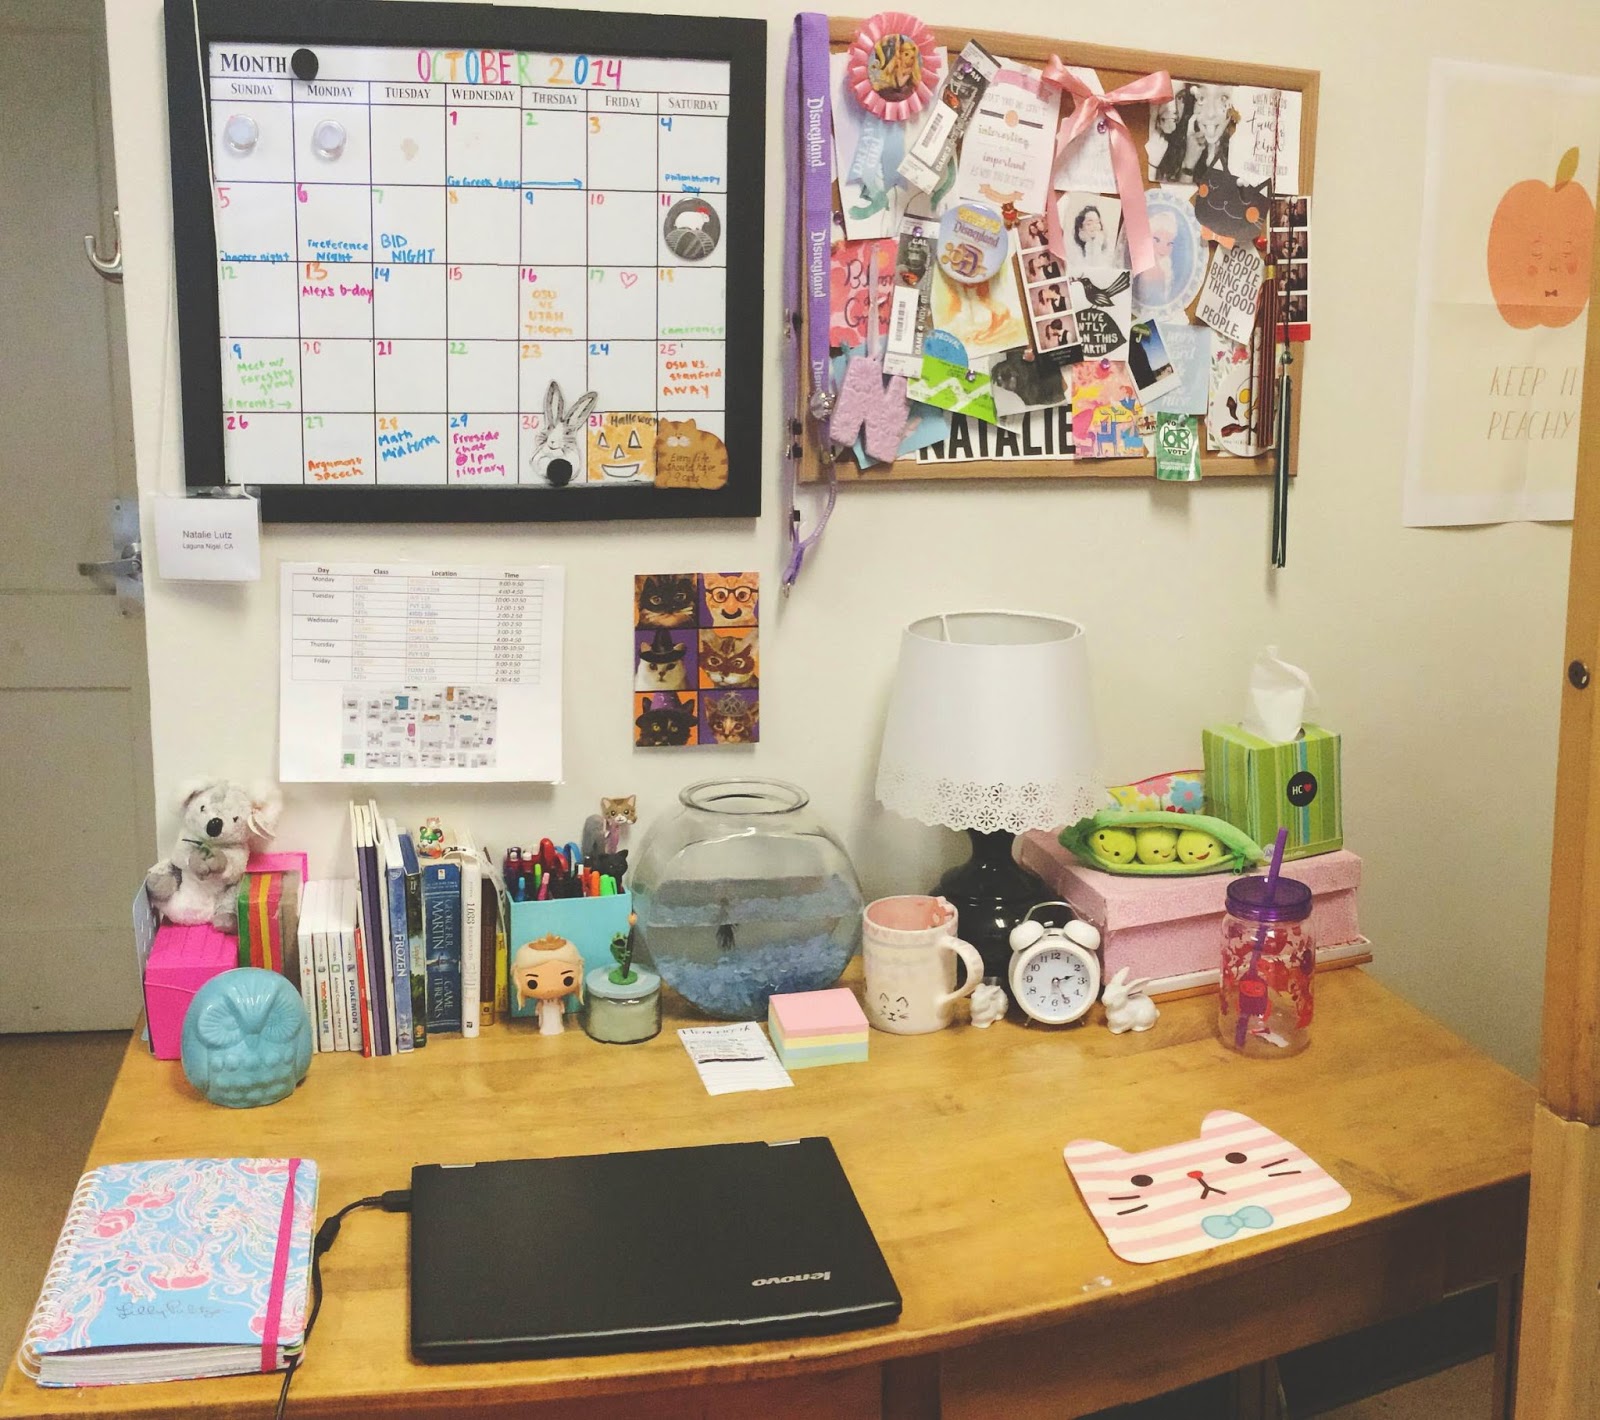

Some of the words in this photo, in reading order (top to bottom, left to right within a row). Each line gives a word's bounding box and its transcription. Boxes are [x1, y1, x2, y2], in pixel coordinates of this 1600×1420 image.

[221, 54, 286, 73] MONTH
[418, 50, 532, 87] OCTOBER
[548, 55, 622, 89] 2014
[231, 83, 273, 95] SUNDAY
[307, 85, 353, 97] MONDAY
[385, 86, 431, 99] TUESDAY
[452, 89, 515, 101] WEDNESDAY
[605, 96, 641, 108] FRIDAY
[668, 98, 719, 111] SATURDAY
[450, 111, 457, 125] 1
[526, 113, 538, 125] 2
[589, 116, 601, 133] 3
[661, 117, 672, 132] 4
[807, 95, 825, 168] Disneyland
[218, 188, 230, 208] 5
[297, 183, 307, 203] 6
[372, 189, 383, 203] 7
[448, 191, 458, 204] 8
[525, 192, 533, 204] 9
[590, 194, 604, 205] 10
[661, 195, 671, 206] 11
[381, 234, 407, 249] BID
[912, 238, 928, 246] CAL
[953, 220, 1000, 248] Disneyland
[392, 248, 435, 263] NIGHT
[810, 229, 828, 299] Disneyland
[1231, 245, 1260, 271] GOOD
[222, 266, 237, 280] 12
[306, 261, 327, 280] 13
[375, 268, 390, 281] 14
[449, 268, 462, 280] 15
[521, 269, 537, 282] 16
[590, 270, 604, 282] 17
[1223, 254, 1259, 287] PEOPLE
[1211, 262, 1240, 291] BRING
[1241, 284, 1257, 300] OU
[340, 284, 373, 303] b-day
[1209, 276, 1225, 298] THE
[1226, 291, 1255, 315] GOOD
[529, 311, 564, 321] UTAH
[1081, 313, 1104, 322] LIVE
[1219, 301, 1232, 318] IN
[1078, 322, 1107, 332] NTLY
[1202, 305, 1239, 339] PEOPLE.
[914, 332, 924, 355] GAME
[1094, 333, 1118, 343] THIS
[377, 342, 392, 355] 21
[450, 342, 468, 355] 22
[522, 344, 542, 358] 23
[589, 344, 609, 355] 24
[660, 344, 676, 355] 25
[1081, 344, 1106, 354] ARTH
[1489, 365, 1546, 397] KEEP
[663, 385, 709, 399] AWAY
[226, 416, 248, 430] 26
[305, 416, 324, 429] 27
[379, 417, 398, 430] 28
[450, 413, 468, 427] 29
[522, 415, 538, 430] 30
[590, 414, 602, 427] 31
[1487, 411, 1576, 440] PEACHY
[378, 430, 413, 445] Math
[1167, 448, 1186, 456] VOTE
[182, 530, 212, 539] Natalie
[214, 531, 232, 539] Lutz
[1292, 785, 1303, 795] HC
[432, 900, 444, 949] MARTIN
[394, 933, 408, 977] FROZEN
[1050, 952, 1061, 960] 12
[1078, 977, 1085, 985] 3
[1051, 999, 1058, 1007] 6
[322, 1021, 330, 1034] LIFE
[751, 1271, 831, 1287] lenovo
